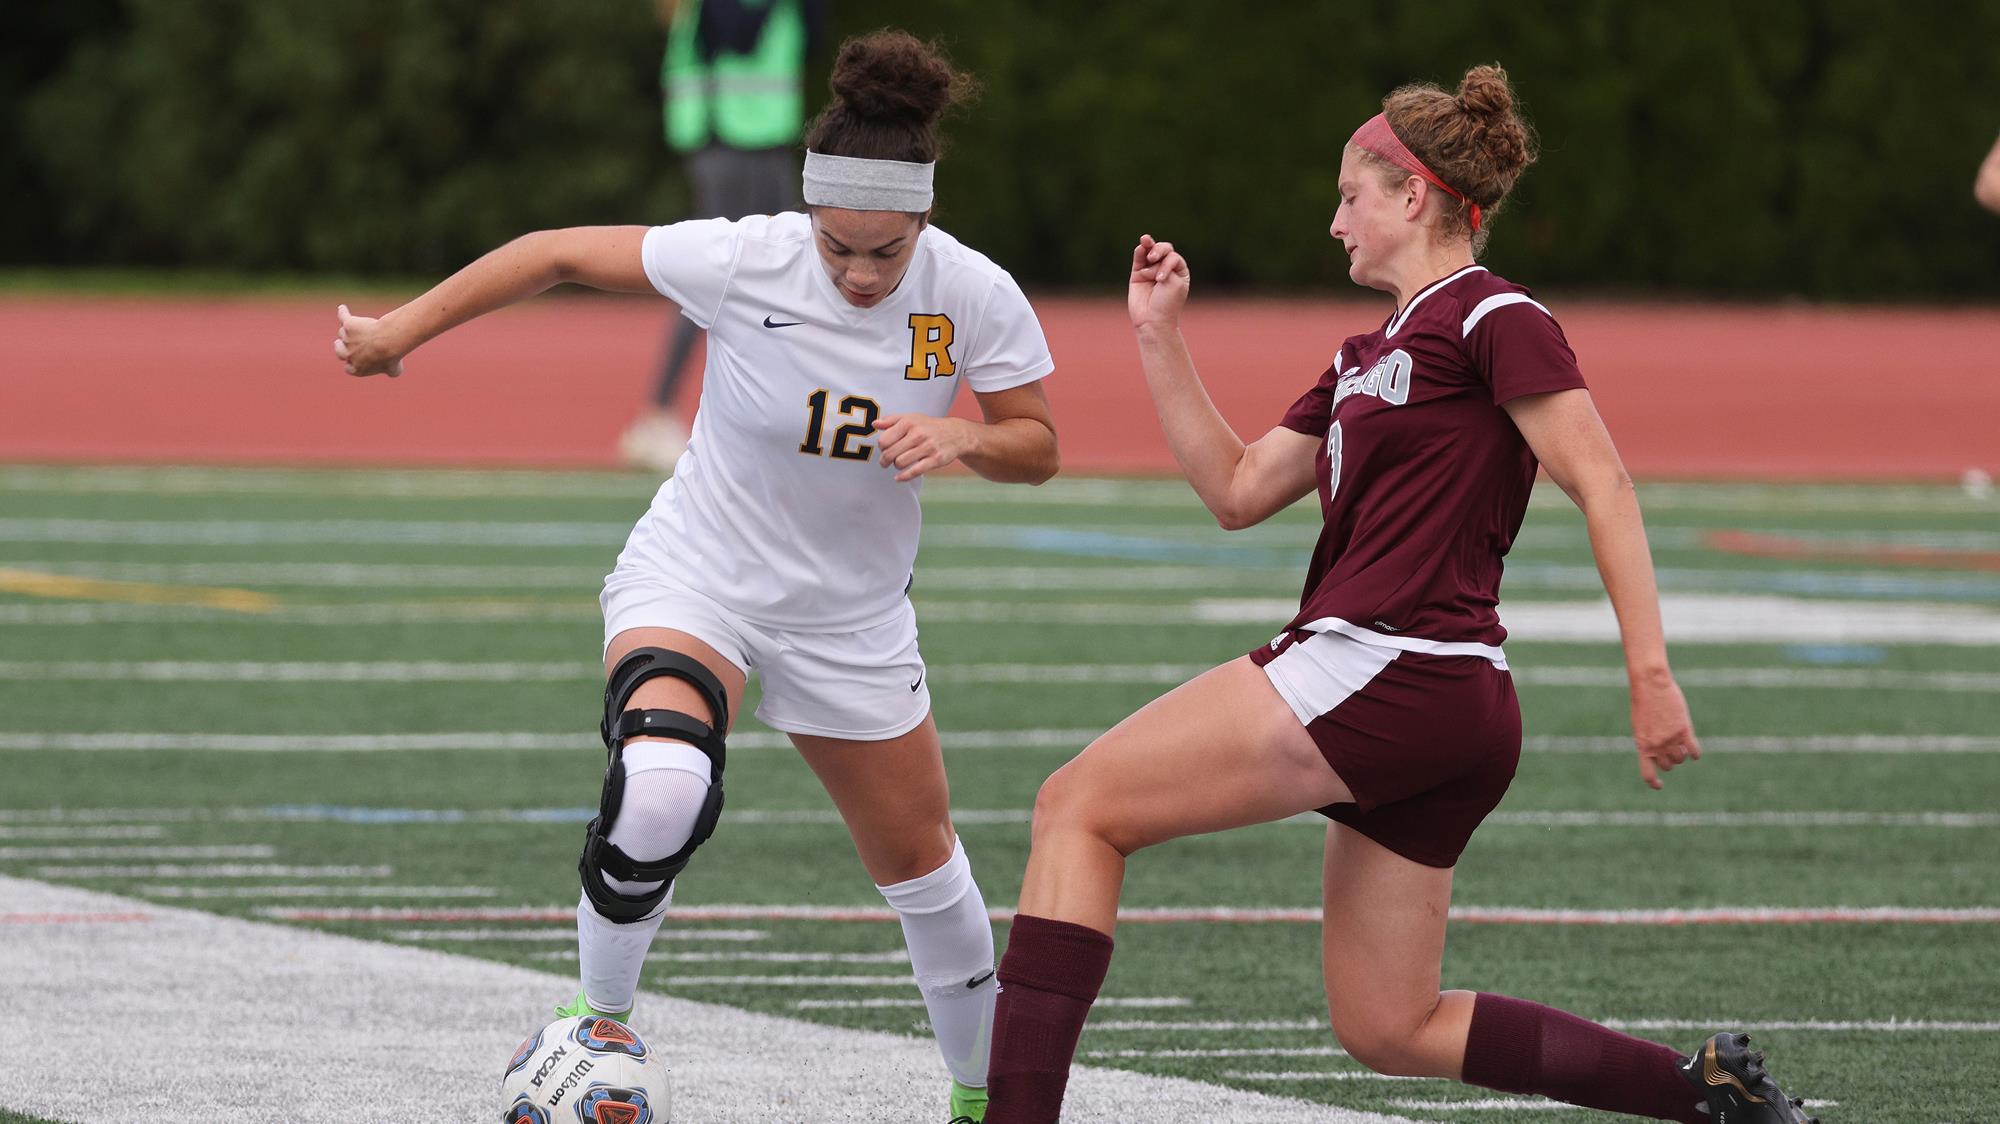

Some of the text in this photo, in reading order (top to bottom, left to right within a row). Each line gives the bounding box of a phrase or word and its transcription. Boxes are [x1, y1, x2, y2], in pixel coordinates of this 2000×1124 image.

[904, 313, 957, 381] R
[798, 388, 881, 465] 12
[530, 1045, 567, 1088] NCAA
[547, 1059, 595, 1106] Wilson
